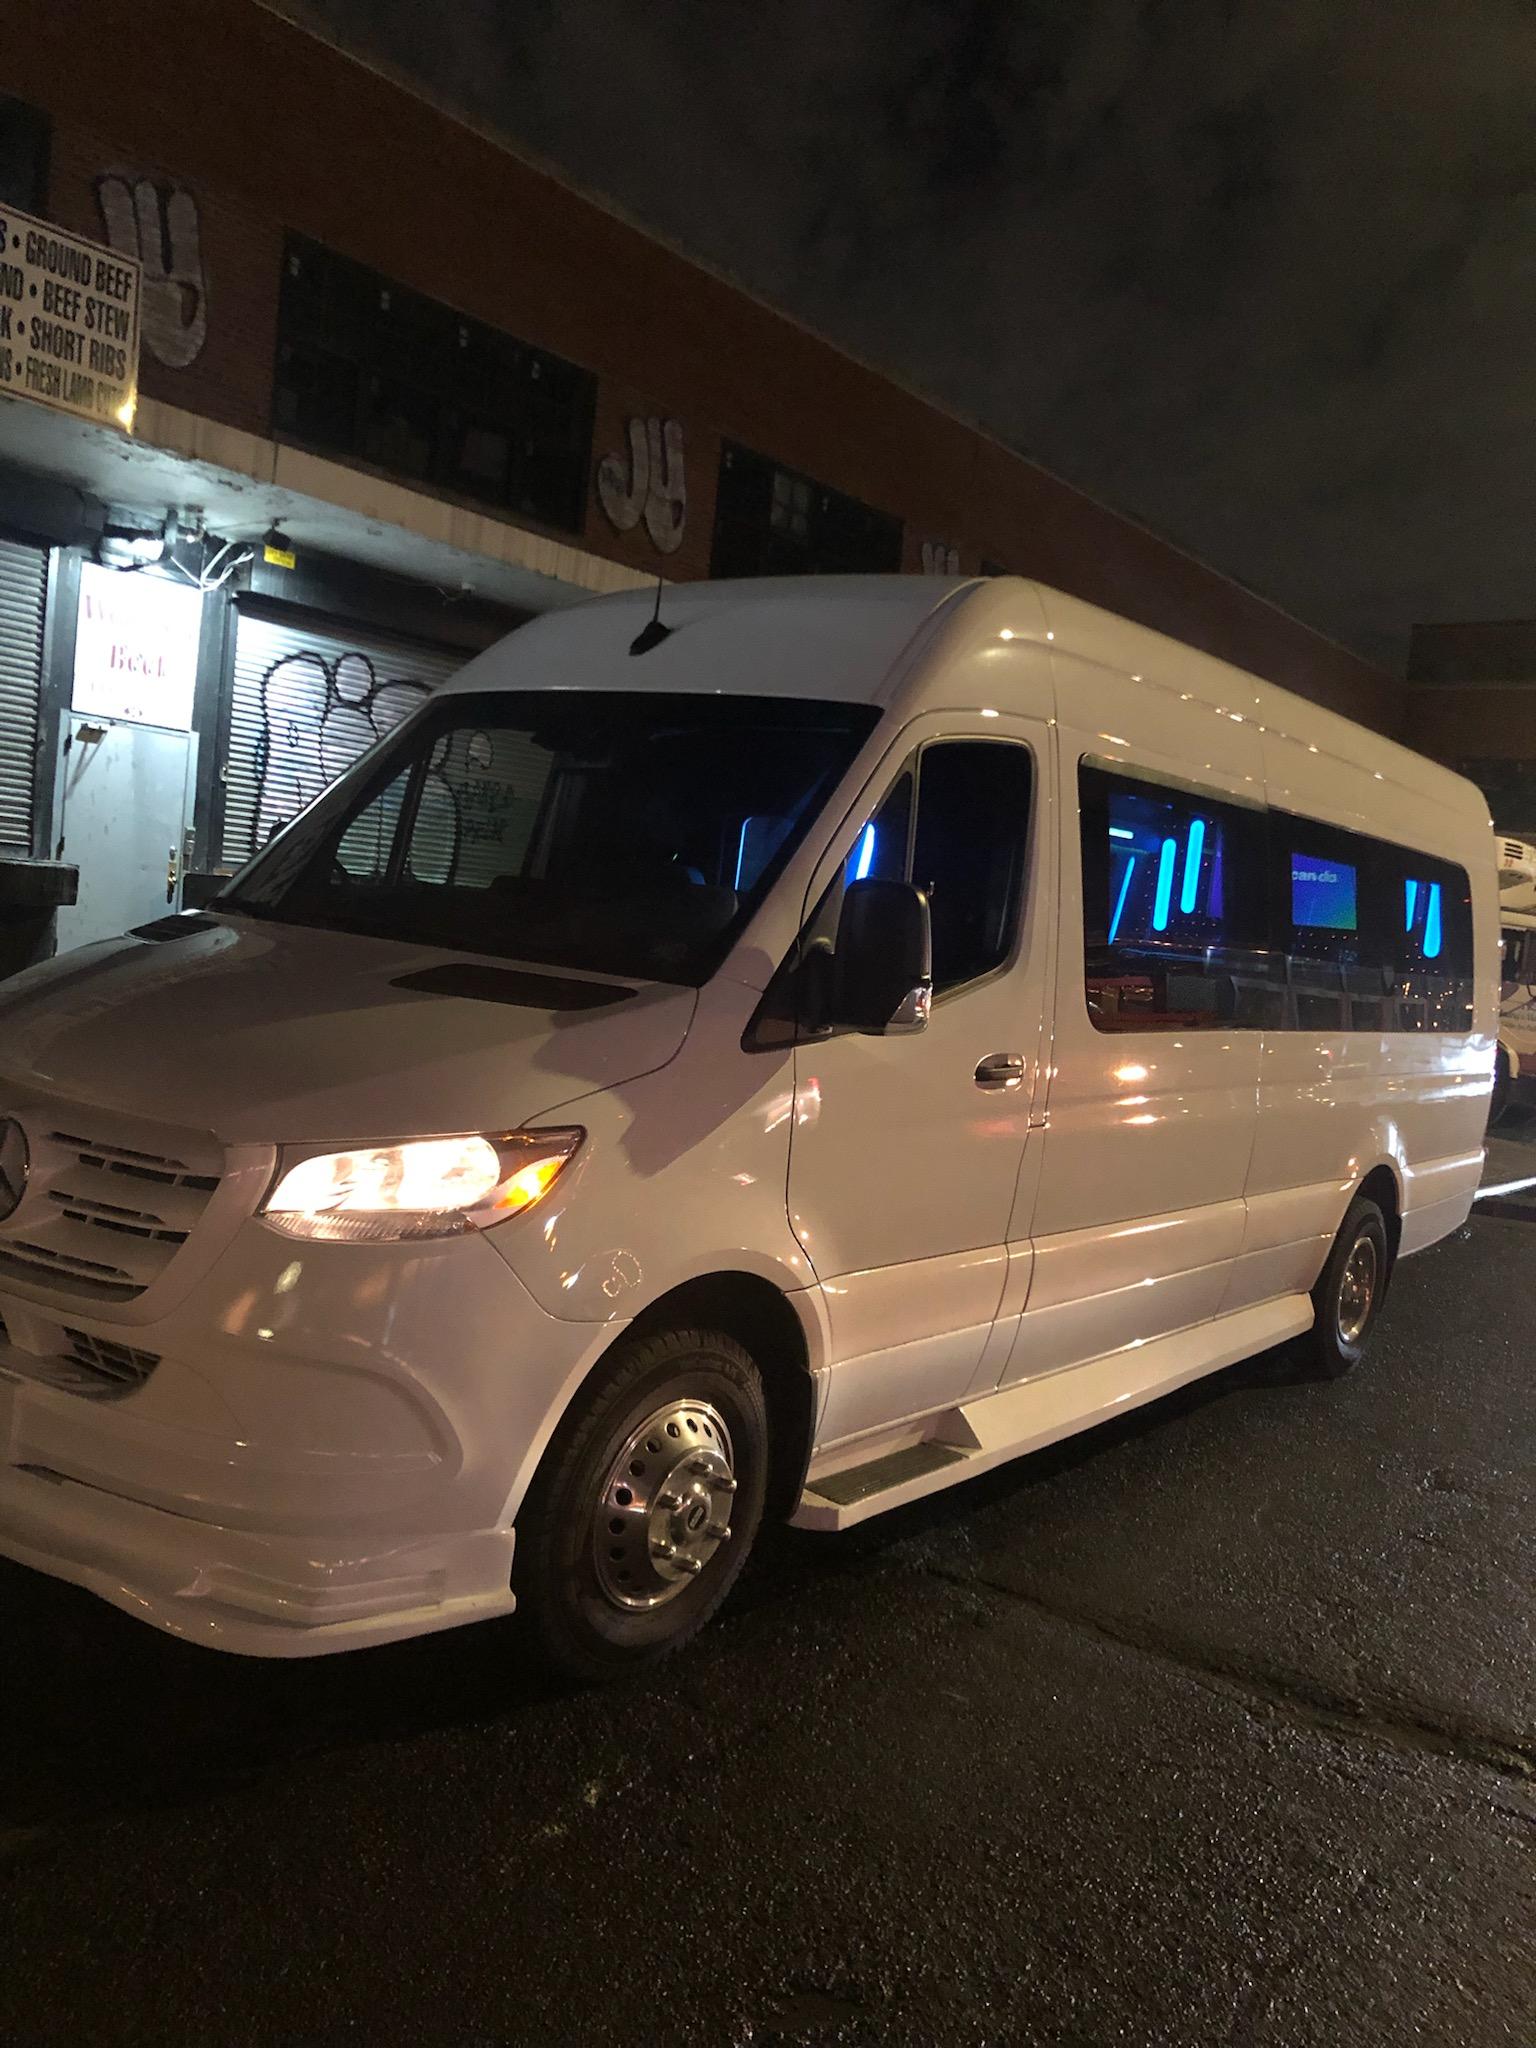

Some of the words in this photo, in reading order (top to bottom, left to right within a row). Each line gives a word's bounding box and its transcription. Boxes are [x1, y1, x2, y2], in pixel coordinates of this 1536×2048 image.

[25, 230, 92, 286] GROUND
[95, 258, 132, 303] BEEF
[43, 278, 81, 322] BEEF
[85, 296, 130, 342] STEW
[25, 355, 61, 398] FRESH
[30, 316, 86, 365] SHORT
[89, 337, 127, 381] RIBS
